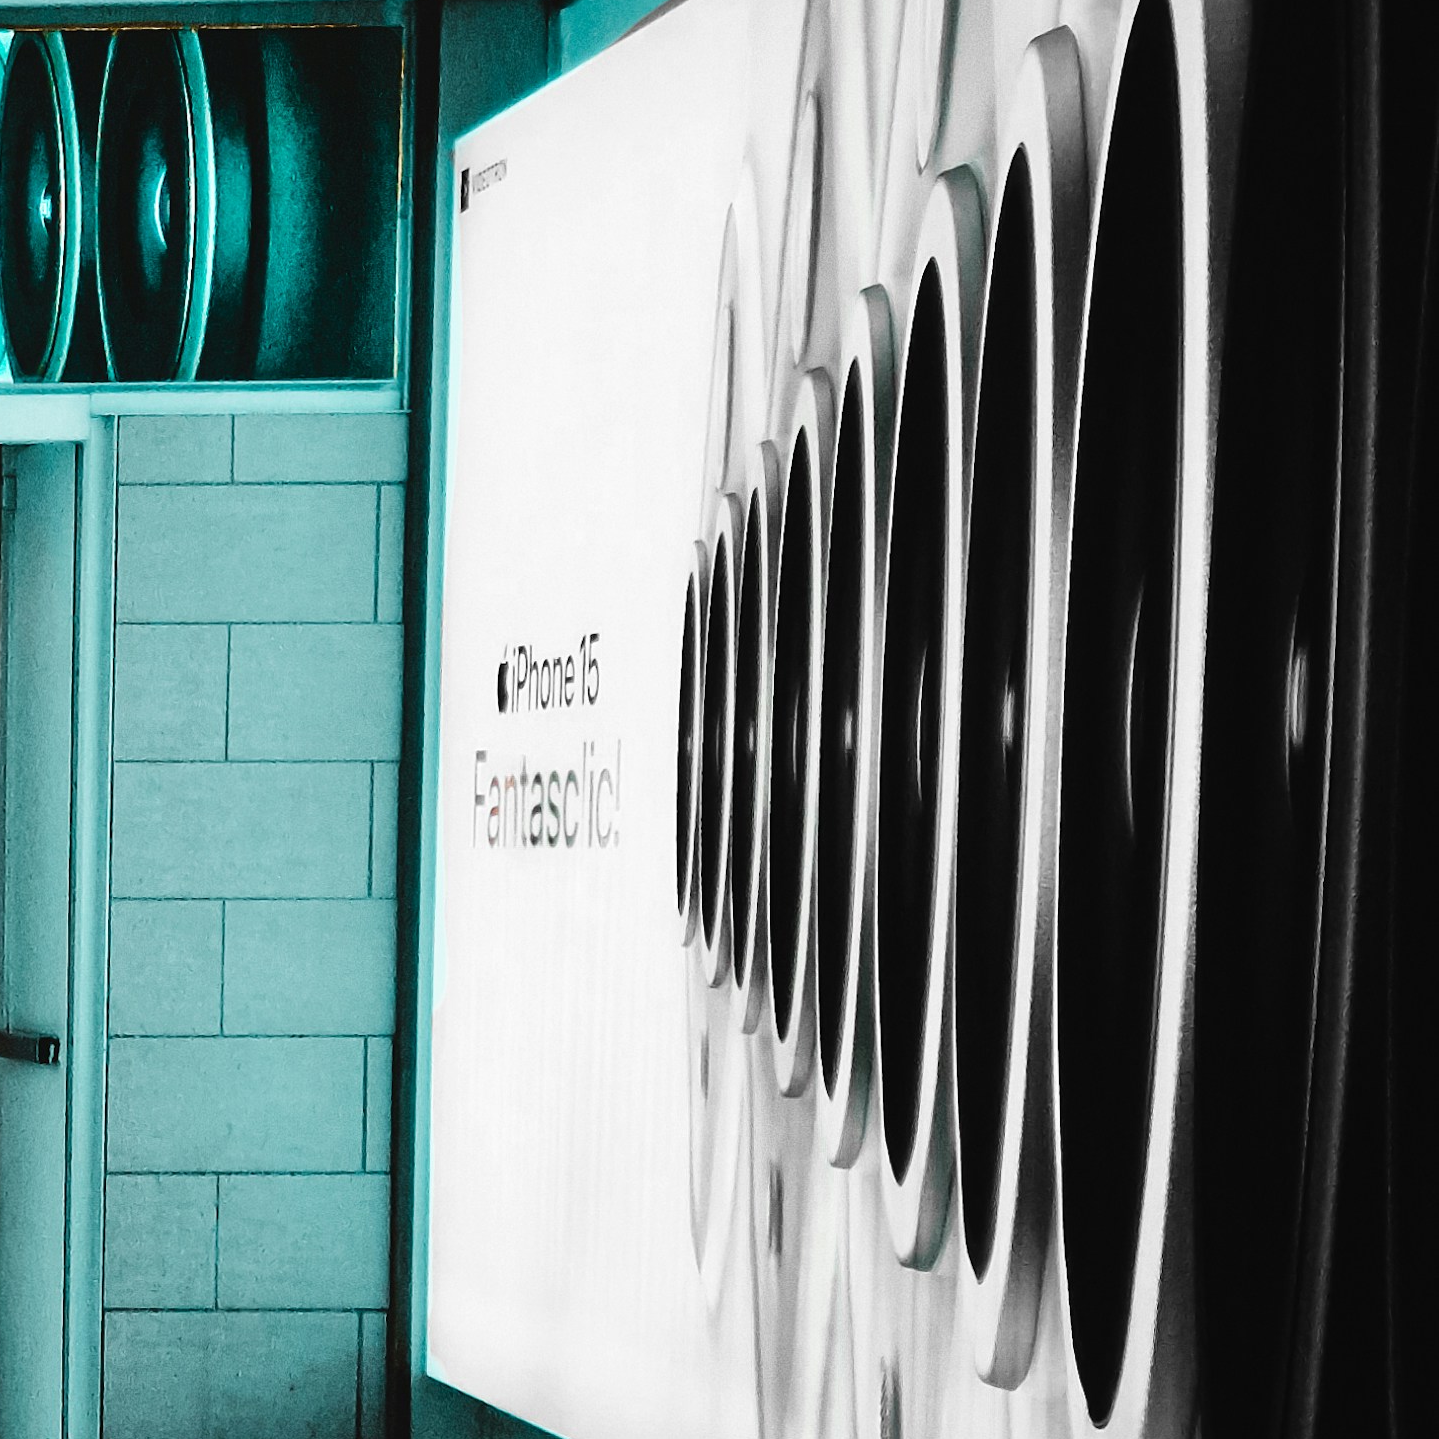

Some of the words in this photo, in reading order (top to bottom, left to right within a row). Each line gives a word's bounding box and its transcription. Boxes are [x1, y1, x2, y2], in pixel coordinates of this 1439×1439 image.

[511, 644, 576, 713] iPhone
[579, 632, 601, 706] 15
[473, 738, 622, 849] Fantasclic!
